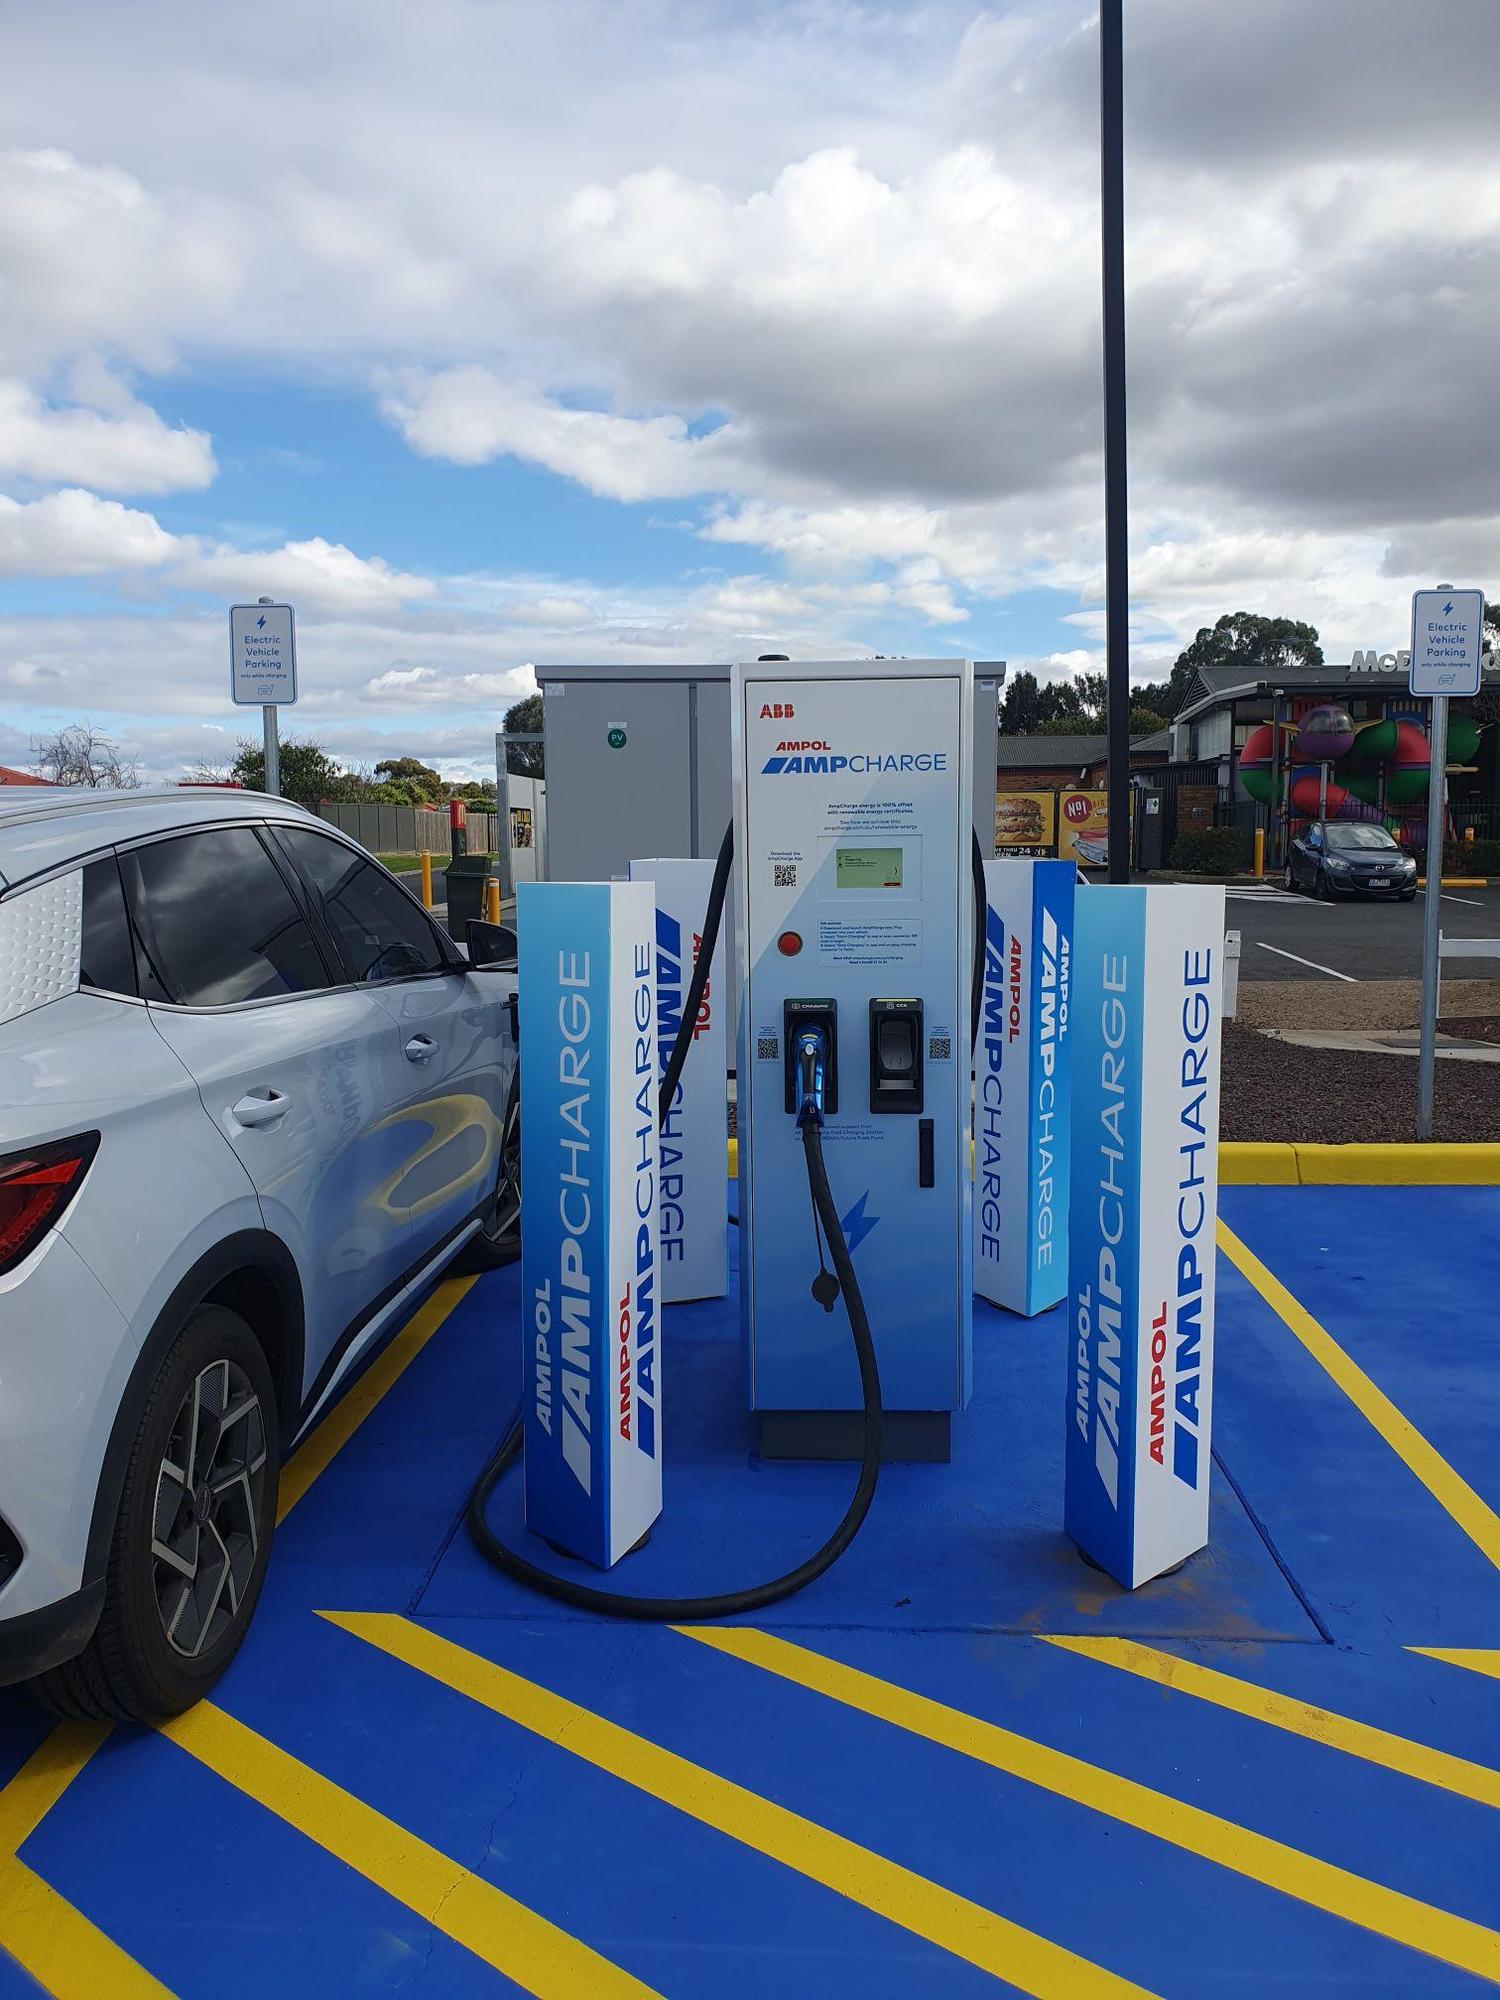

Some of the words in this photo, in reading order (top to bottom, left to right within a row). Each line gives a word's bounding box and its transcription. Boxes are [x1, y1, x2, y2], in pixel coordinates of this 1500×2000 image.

[244, 635, 281, 644] Electric
[245, 660, 282, 670] Parking
[246, 648, 280, 656] Vehicle
[1427, 648, 1466, 659] Parking
[1428, 622, 1467, 632] Electric
[1429, 635, 1465, 644] Vehicle
[760, 704, 795, 719] ABB
[776, 741, 831, 751] AMPOL
[783, 753, 947, 774] AMPCHARGE
[1009, 934, 1022, 1044] AMPOL
[1059, 934, 1070, 1042] AMPOL
[982, 950, 1004, 1263] AMPCHARGE
[1038, 953, 1057, 1270] AMPCHARGE
[559, 950, 591, 1434] AMPCHARGE
[635, 941, 655, 1399] AMPCHARGE
[1097, 952, 1128, 1447] AMPCHARGE
[1174, 947, 1211, 1427] AMPCHARGE
[535, 1278, 552, 1437] AMPOL
[619, 1281, 631, 1441] AMPOL
[1075, 1283, 1091, 1444] AMPOL
[1150, 1300, 1167, 1465] AMPOL
